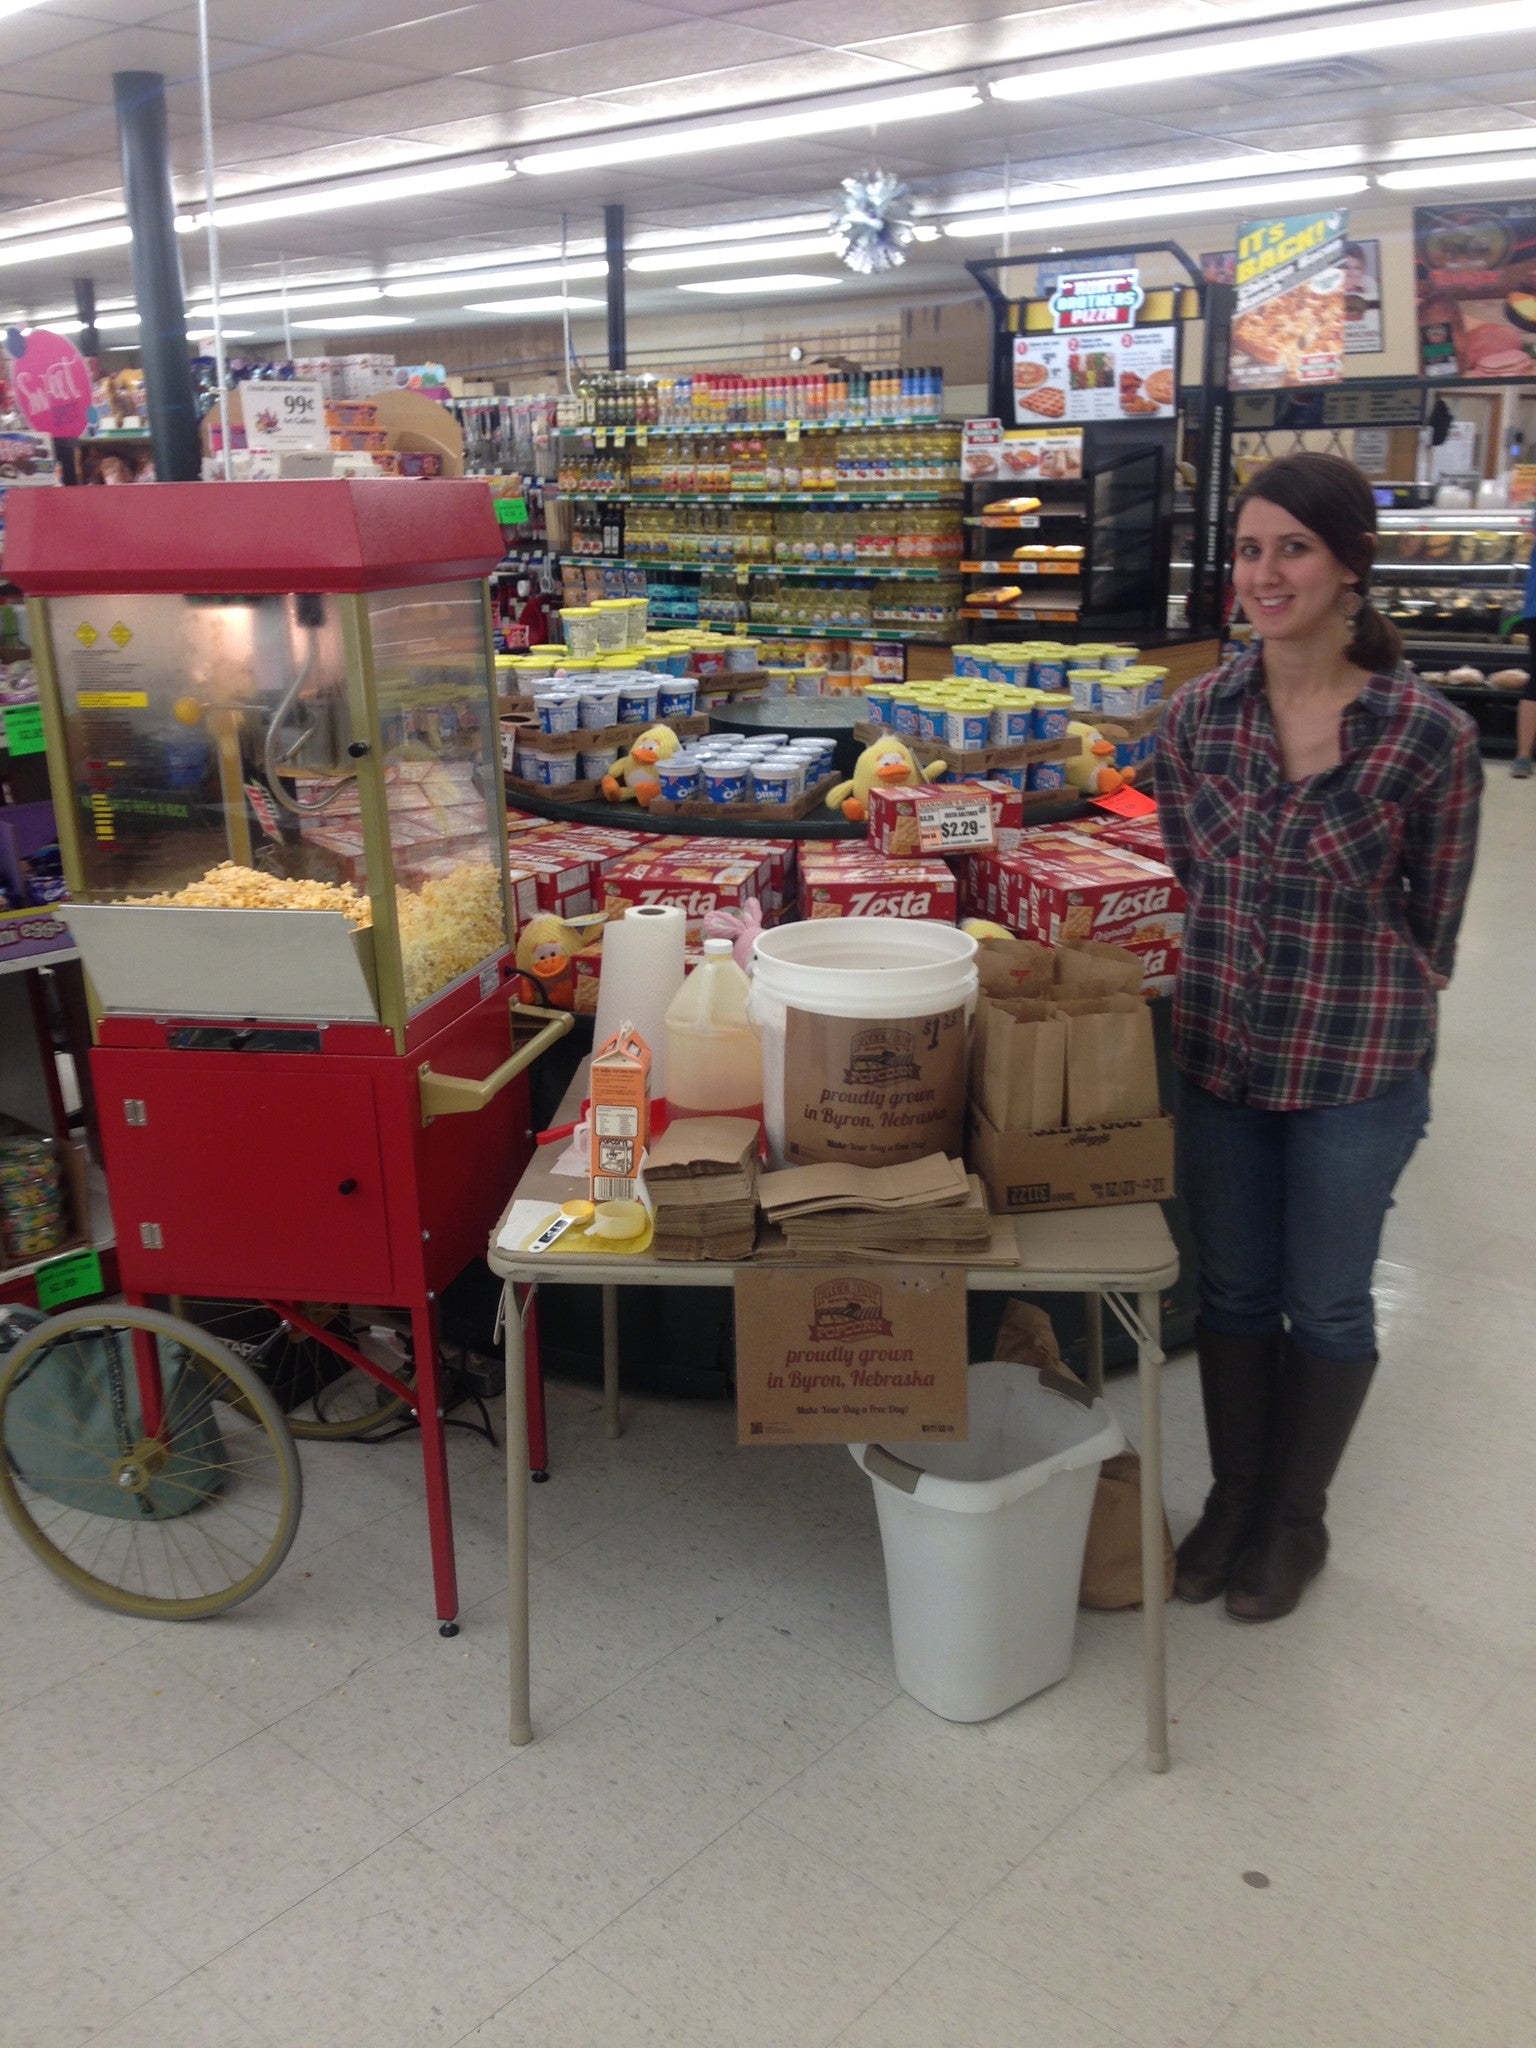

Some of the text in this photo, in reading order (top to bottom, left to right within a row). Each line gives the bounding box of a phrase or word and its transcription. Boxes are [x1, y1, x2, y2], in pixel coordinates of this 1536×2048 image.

[941, 820, 978, 838] $2.29
[639, 890, 718, 917] Zesta
[848, 890, 932, 918] Zesta
[1093, 886, 1172, 927] Zesta
[819, 1088, 935, 1109] proudly grown
[804, 1104, 947, 1130] in Byron, Nebraska
[785, 1346, 913, 1367] proudly grown
[767, 1369, 935, 1392] in Byron, Nebraska
[796, 1405, 819, 1415] Make
[843, 1405, 861, 1415] Day
